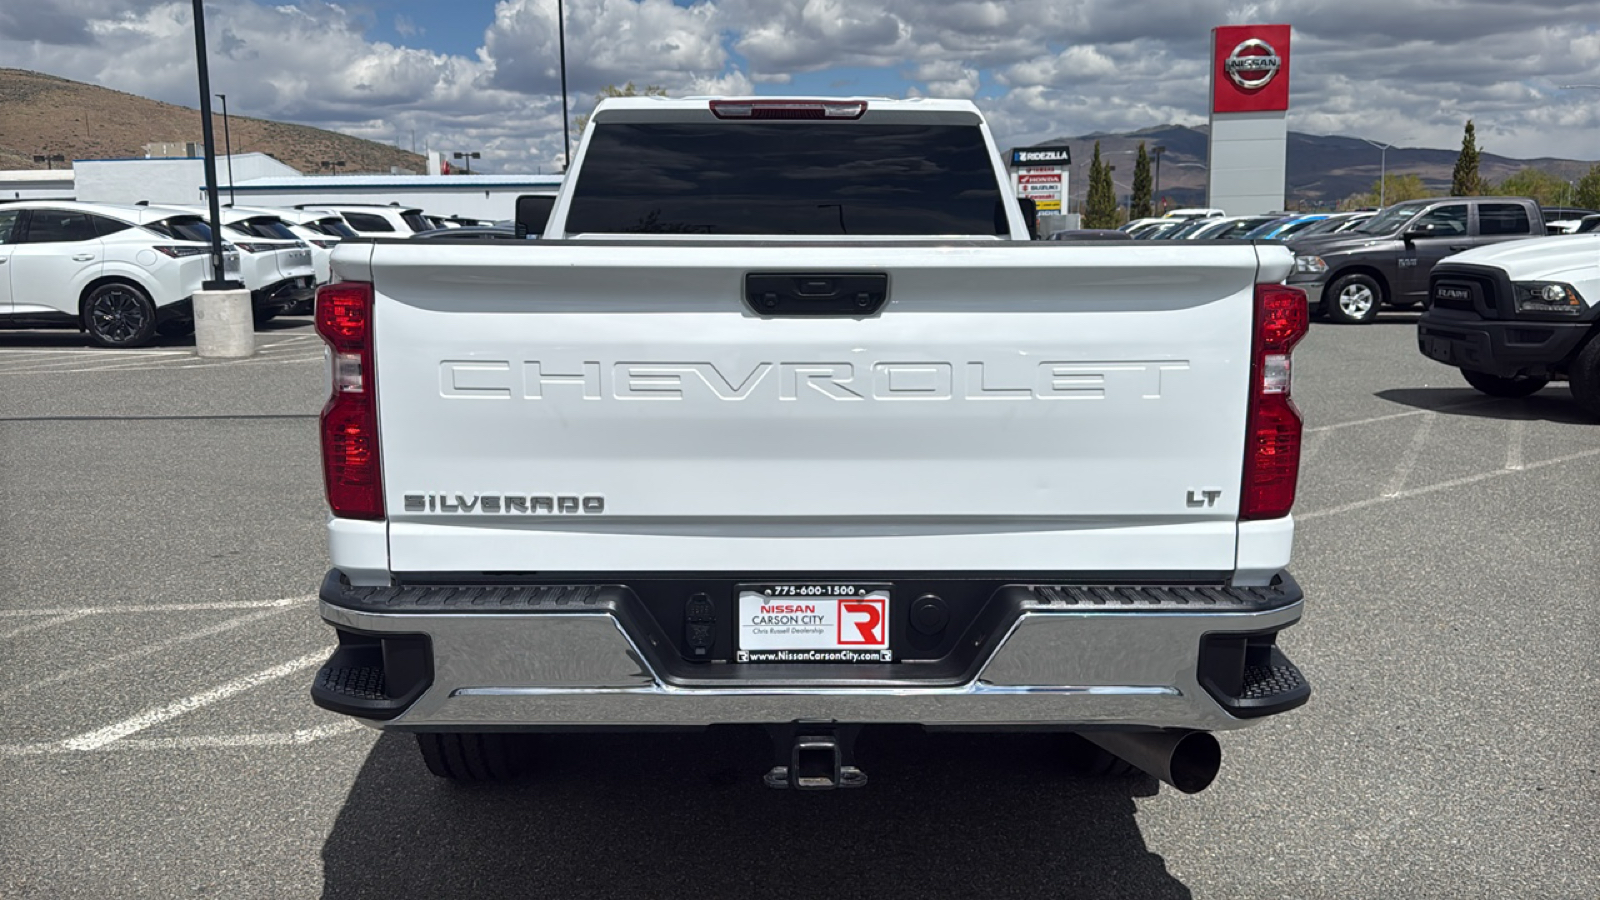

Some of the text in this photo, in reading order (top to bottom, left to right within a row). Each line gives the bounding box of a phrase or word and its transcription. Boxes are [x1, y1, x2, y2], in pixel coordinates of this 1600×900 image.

[1230, 59, 1277, 67] NISSAN
[1027, 151, 1068, 160] RIDEZILLA
[1438, 289, 1469, 299] RAM
[438, 359, 1190, 402] CHEVROLET
[404, 494, 605, 514] SILVERADO
[1186, 490, 1222, 508] LT
[774, 586, 855, 595] 775-600-1500
[760, 605, 815, 614] NISSAN
[752, 615, 825, 625] CARSON CITY
[752, 627, 824, 636] Chris Russell Dealership
[750, 650, 880, 661] www.NissanCarsonCity.com
